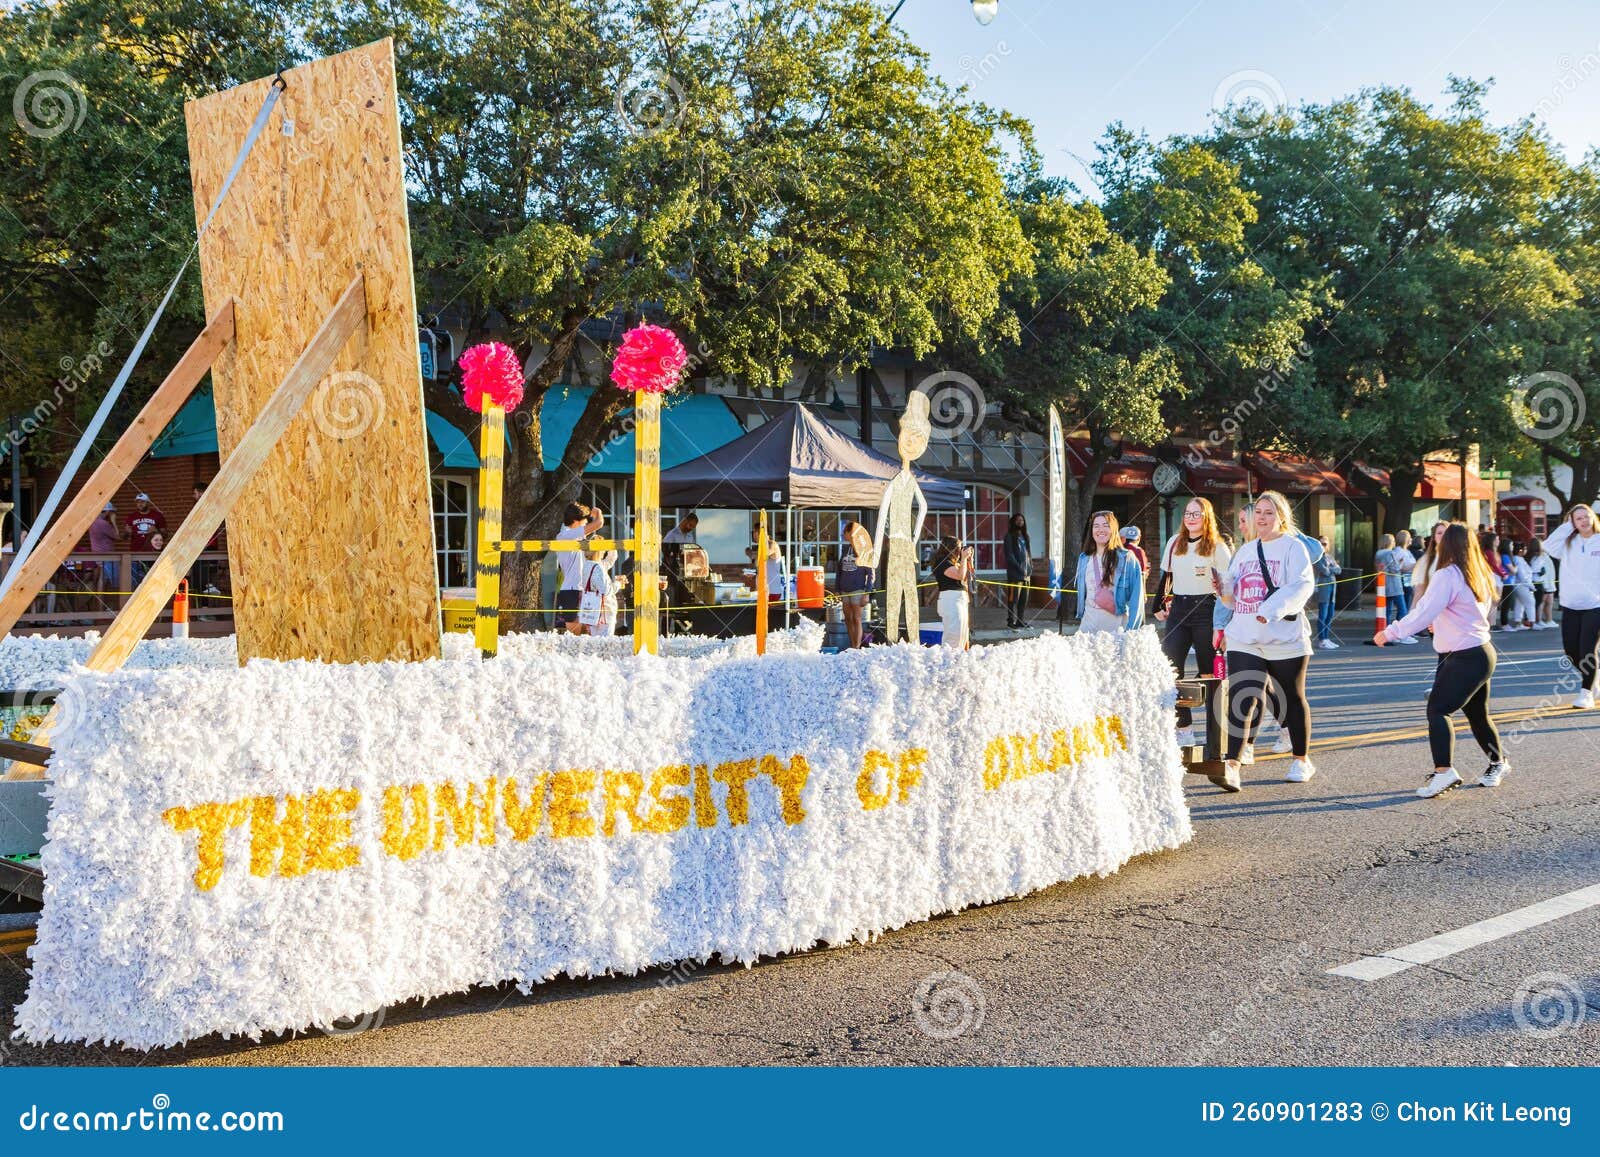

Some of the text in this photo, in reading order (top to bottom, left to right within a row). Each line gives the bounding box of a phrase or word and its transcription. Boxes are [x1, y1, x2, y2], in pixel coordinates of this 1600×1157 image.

[162, 787, 362, 892] THE
[380, 753, 809, 861] UNIVERSITY
[857, 747, 929, 810] OF
